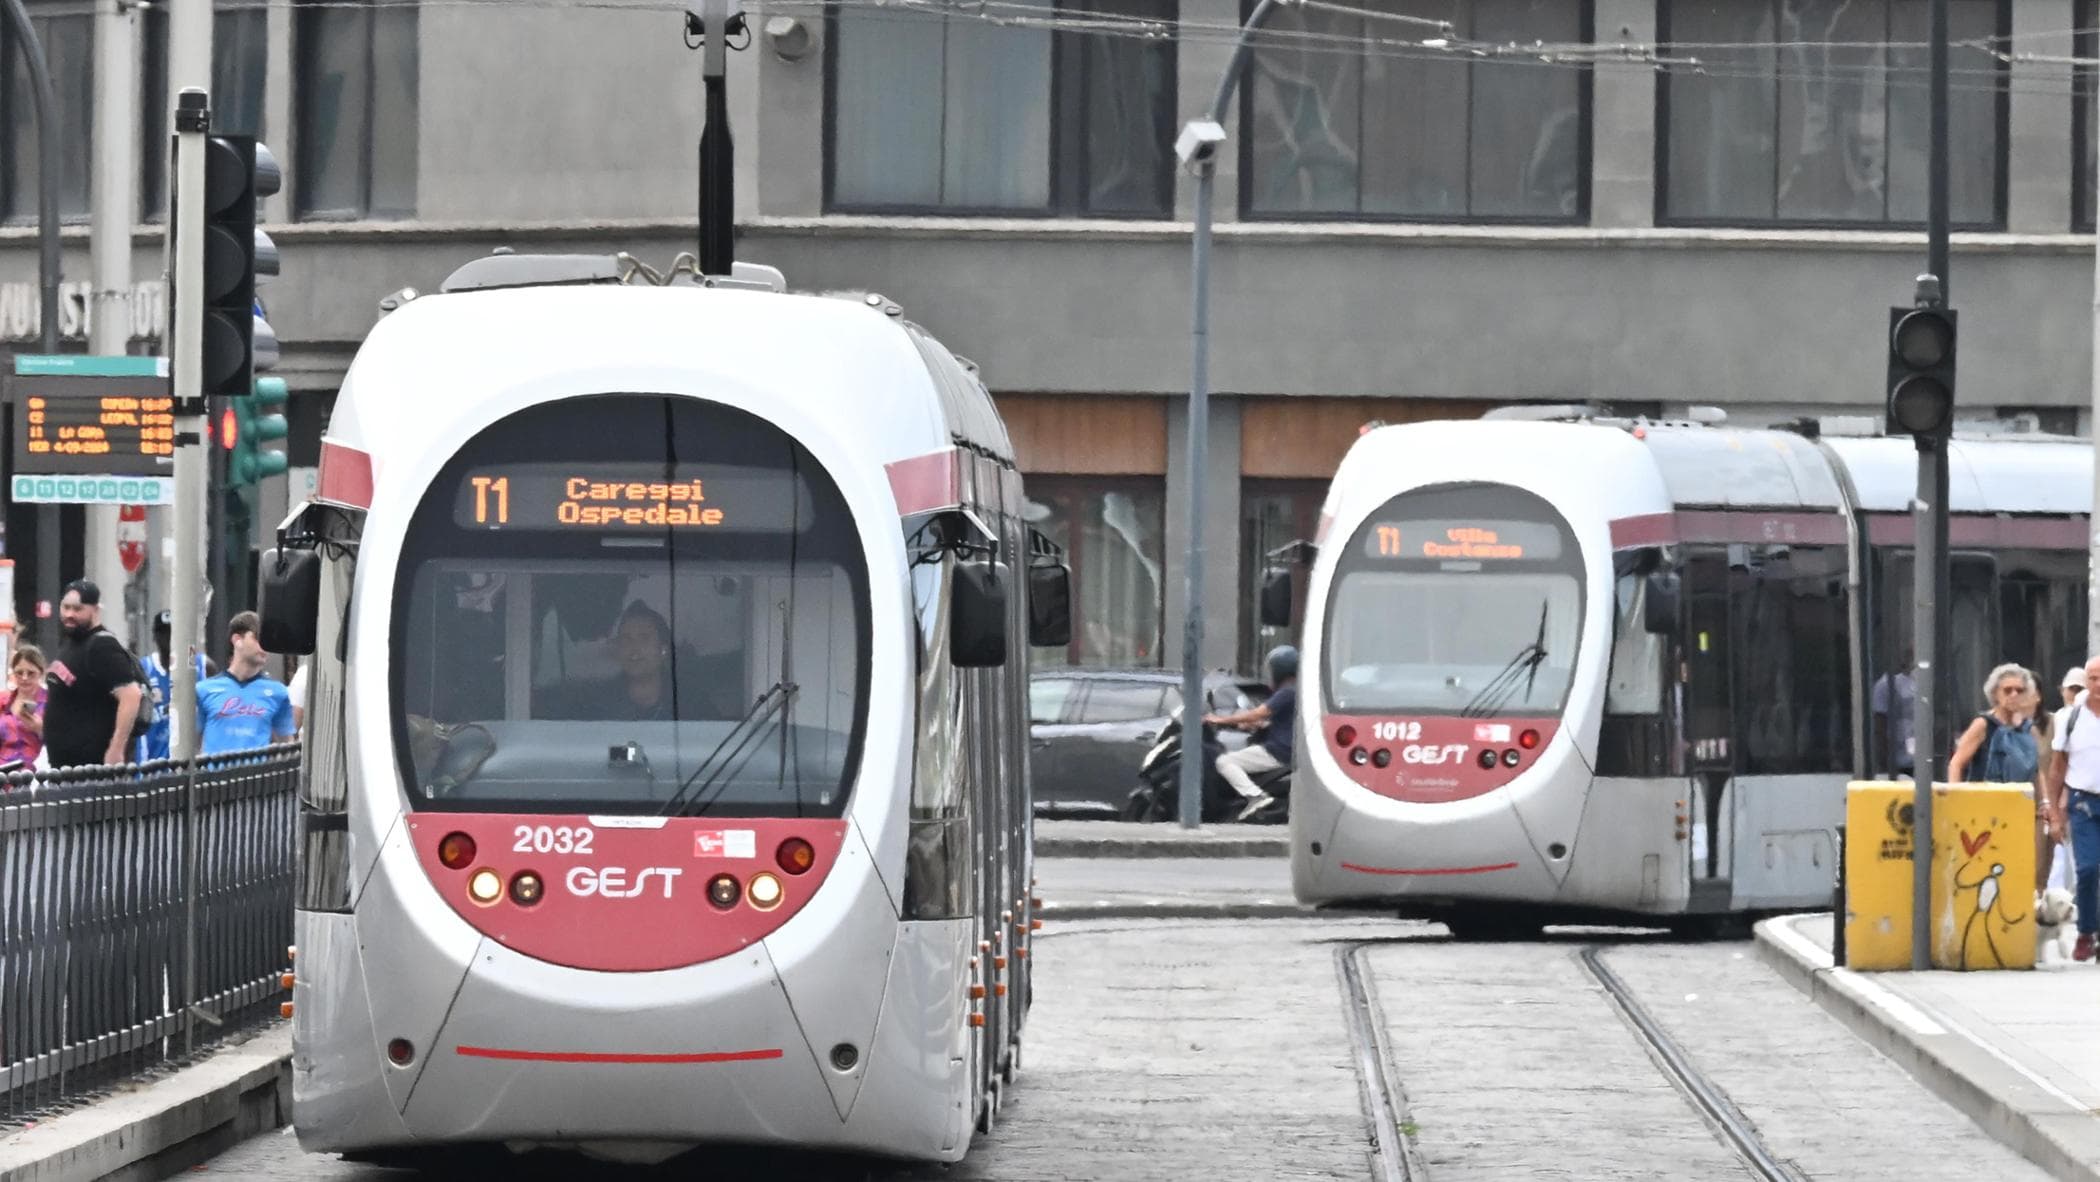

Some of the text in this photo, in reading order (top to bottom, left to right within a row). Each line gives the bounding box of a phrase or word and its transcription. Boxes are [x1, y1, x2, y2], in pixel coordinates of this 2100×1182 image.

[472, 476, 508, 523] T1
[566, 477, 705, 500] Careggi
[558, 501, 724, 525] Ospedale
[1376, 526, 1400, 556] T1
[1372, 721, 1422, 740] 1012
[1402, 744, 1470, 764] GEST
[512, 825, 594, 854] 2032
[566, 866, 682, 898] GEST
